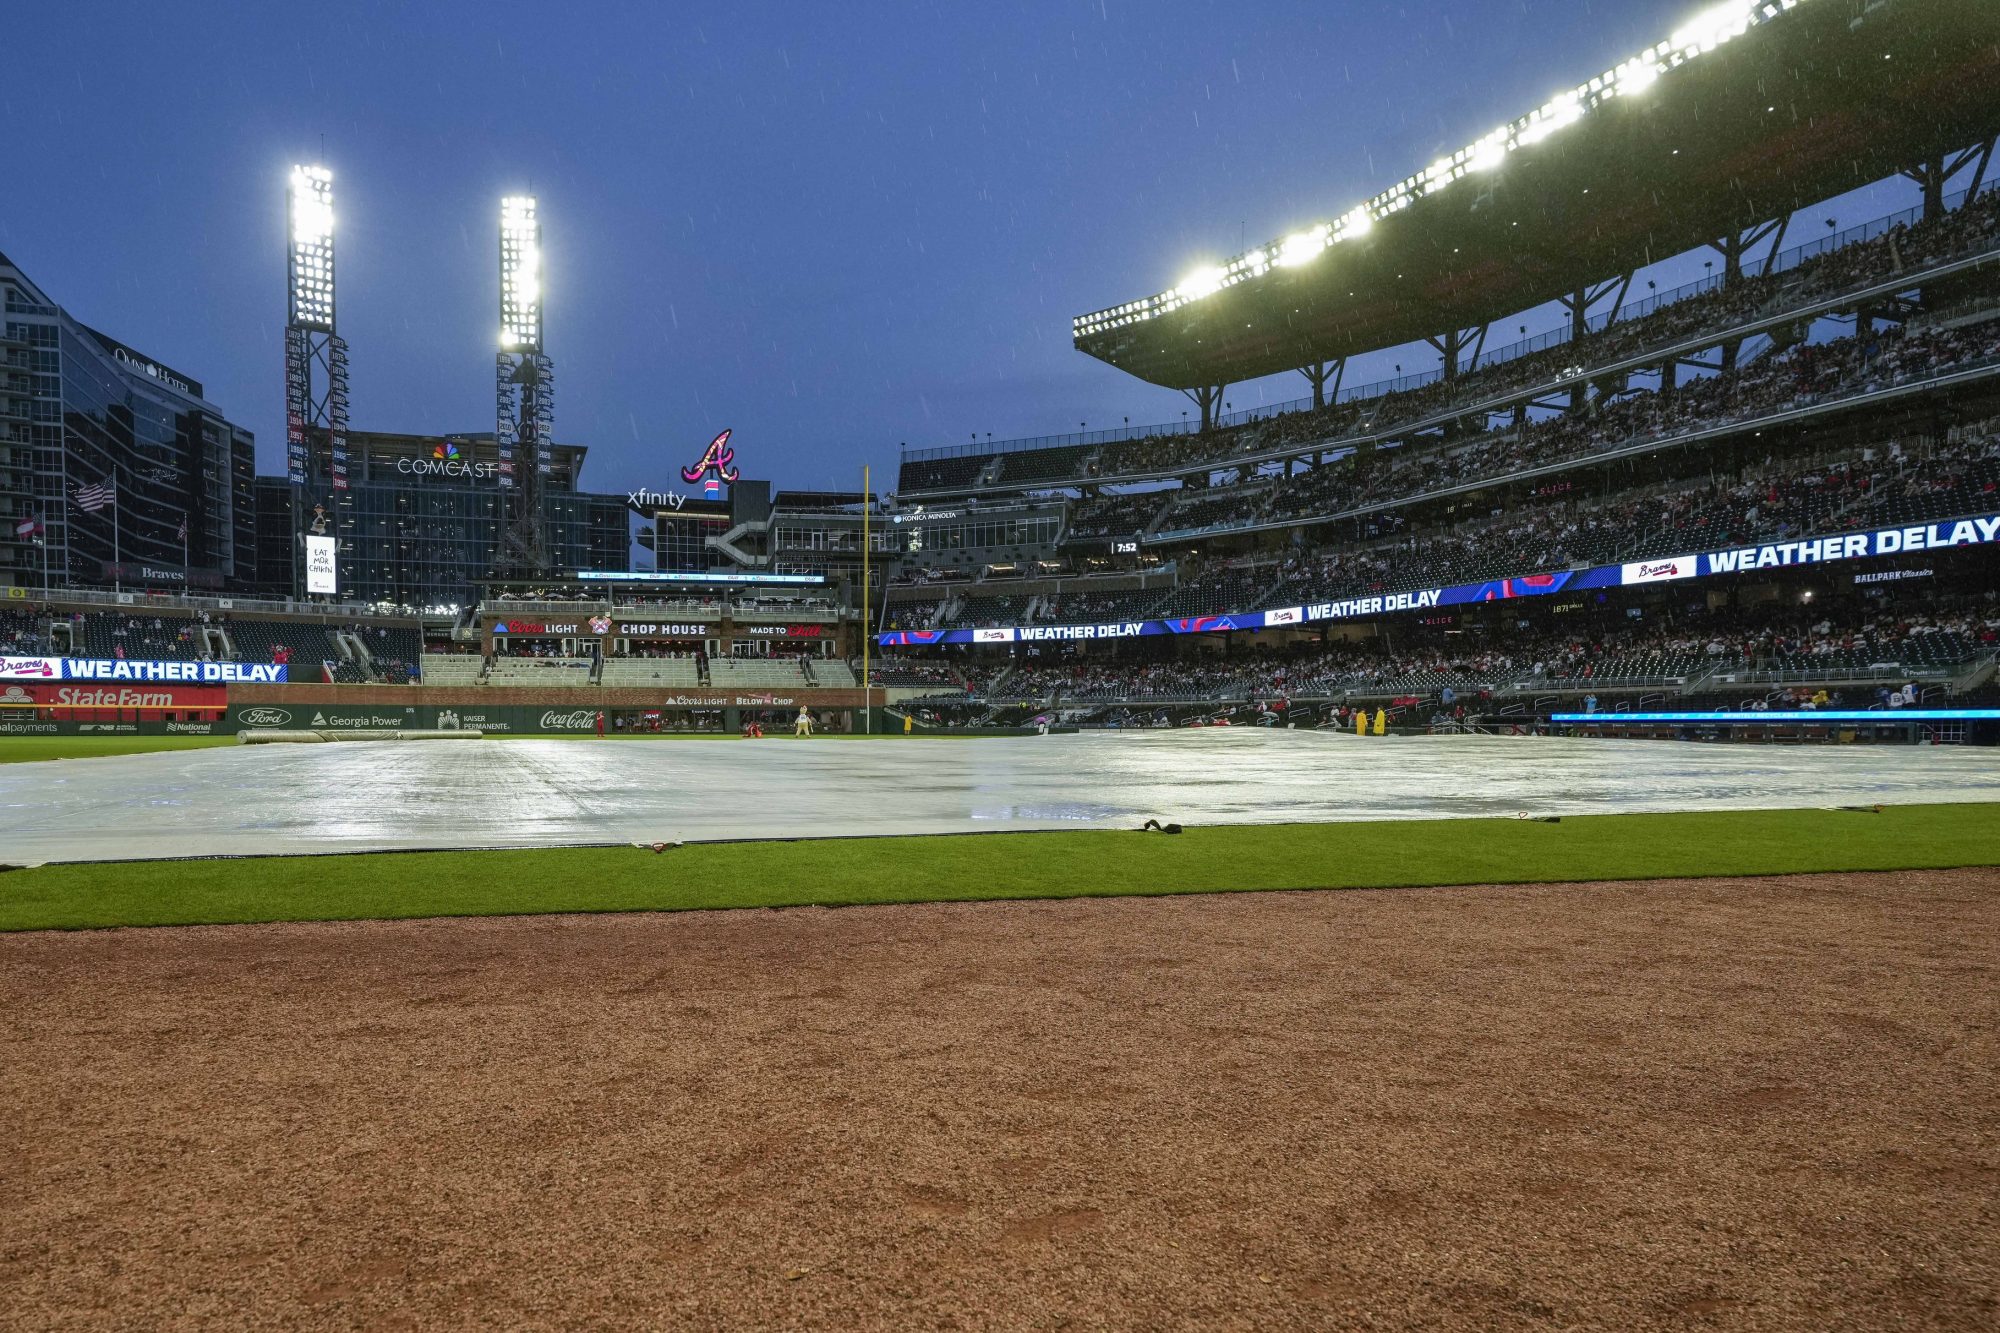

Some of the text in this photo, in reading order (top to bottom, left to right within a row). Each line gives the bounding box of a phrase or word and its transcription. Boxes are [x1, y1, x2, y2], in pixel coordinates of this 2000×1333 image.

[332, 352, 344, 362] 1875
[290, 430, 303, 440] 1957
[681, 428, 739, 484] A
[398, 458, 496, 478] COMCAST
[291, 474, 304, 483] 1993
[628, 488, 686, 510] xfinity
[1118, 543, 1136, 552] 7:52
[1706, 516, 2000, 573] WEATHER DELAY
[142, 567, 184, 580] Braves
[309, 565, 332, 573] CHIKIN
[1639, 562, 1672, 578] Braves
[1854, 568, 1934, 583] BALLPARK Classics
[1308, 597, 1382, 620] WEATHER
[1385, 589, 1442, 611] DELAY
[508, 619, 578, 633] Coors LIGHT
[1426, 616, 1452, 625] SLICE
[621, 624, 706, 634] CHOP HOUSE
[1020, 626, 1095, 640] WEATHER
[1098, 623, 1144, 637] DELAY
[68, 660, 199, 680] WEATHER
[204, 663, 282, 681] DELAY
[676, 696, 702, 705] Coors
[248, 709, 282, 724] Ford
[330, 716, 402, 728] Georgia Power
[540, 710, 596, 729] Coca-Cola
